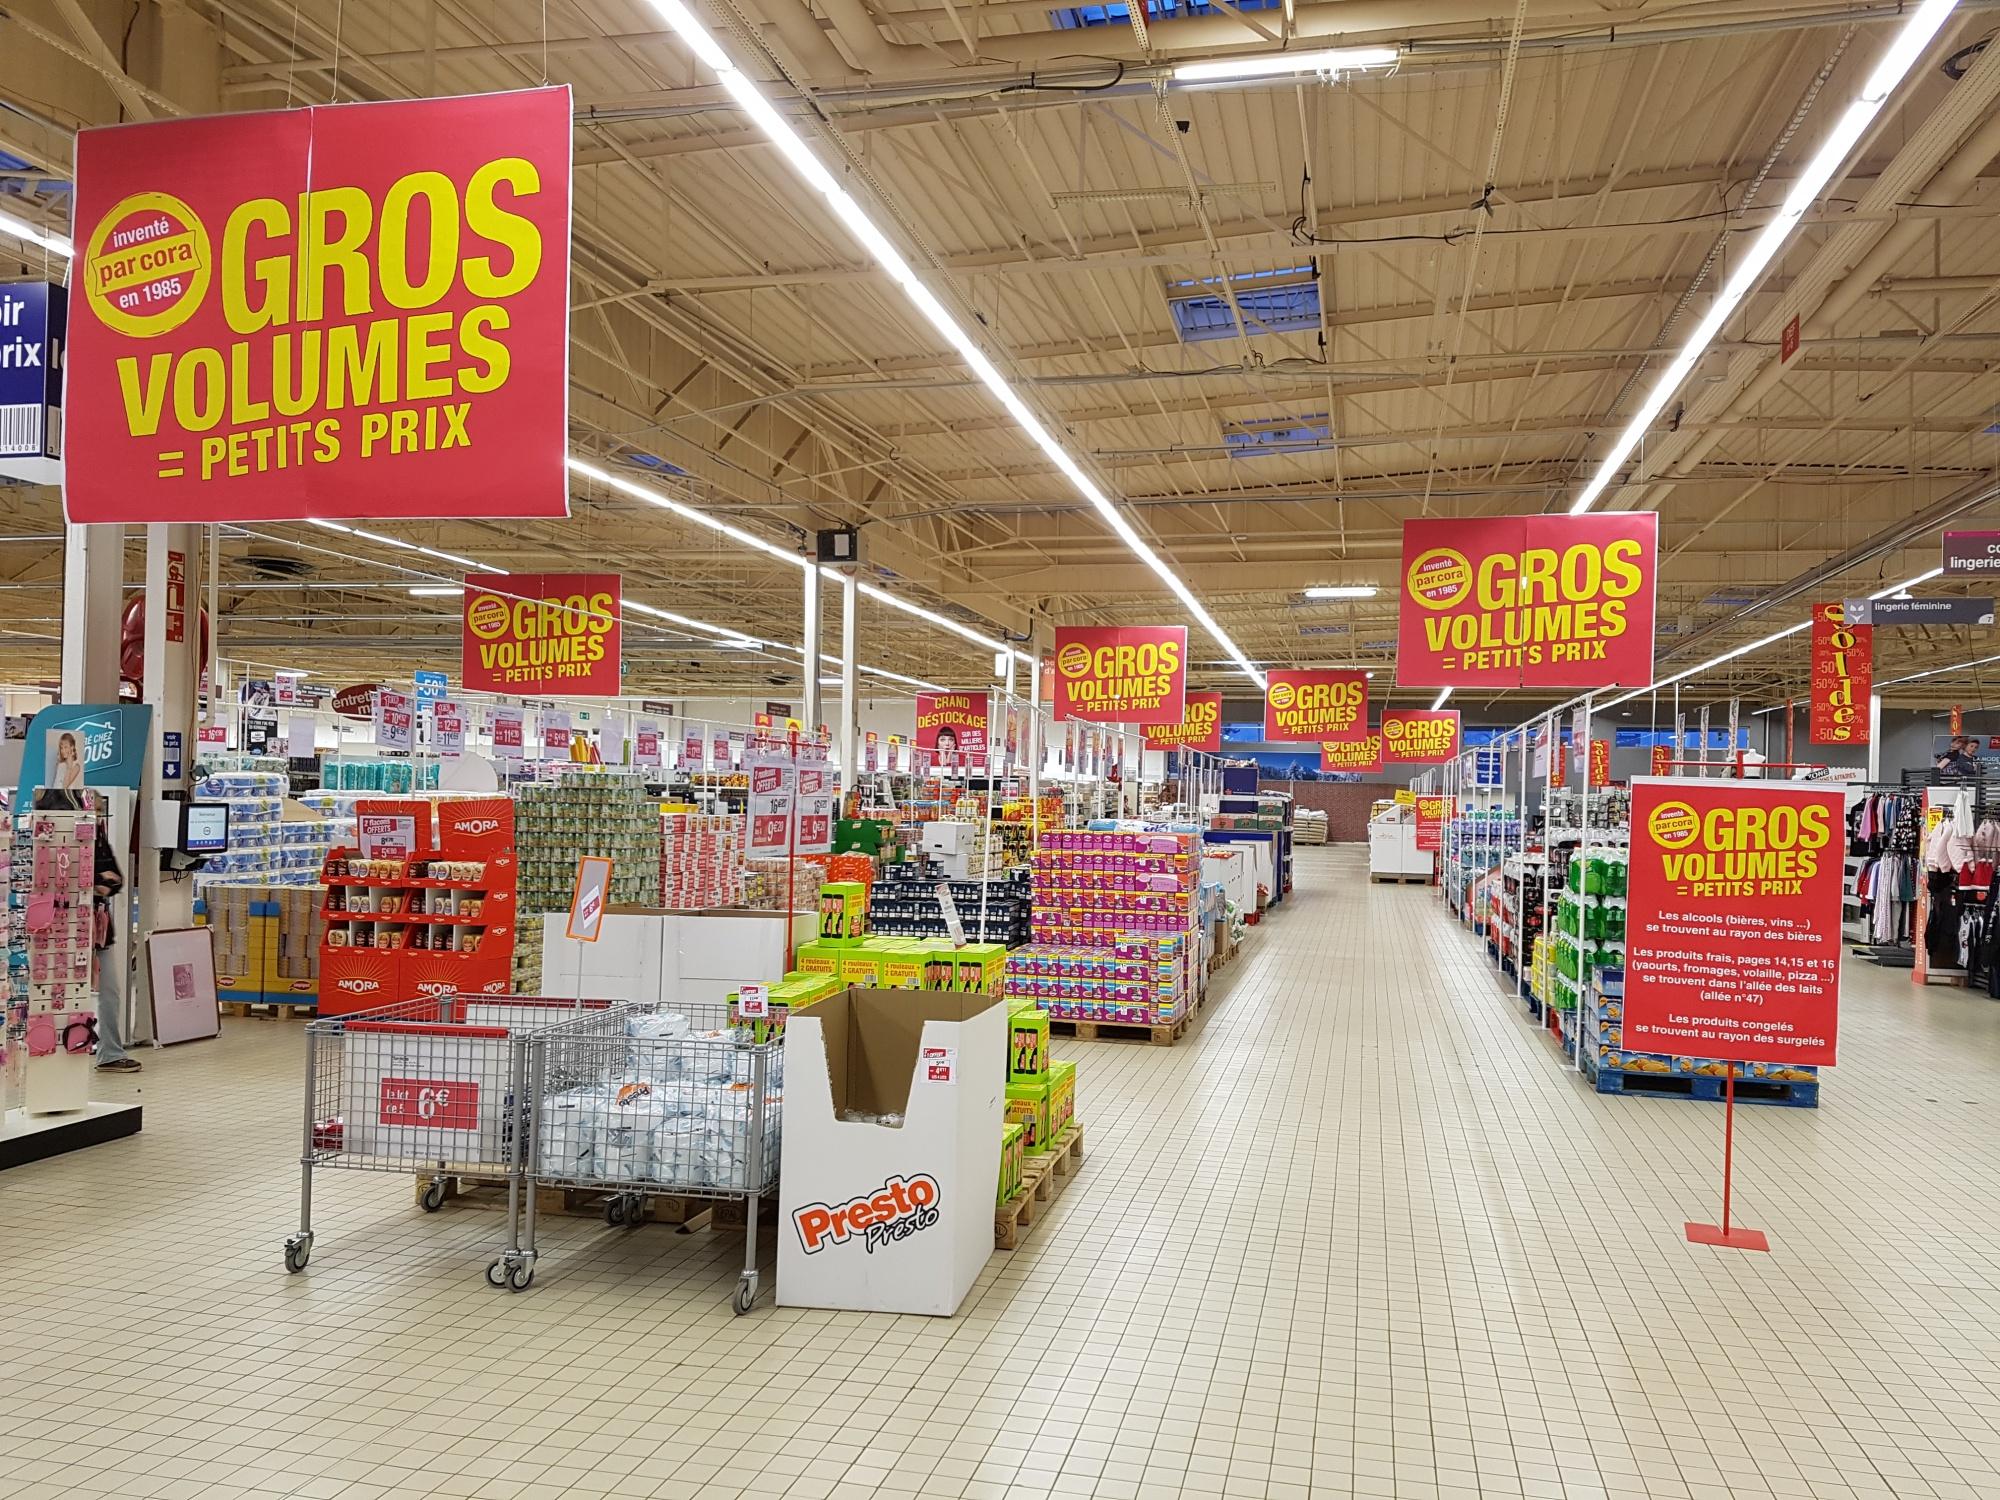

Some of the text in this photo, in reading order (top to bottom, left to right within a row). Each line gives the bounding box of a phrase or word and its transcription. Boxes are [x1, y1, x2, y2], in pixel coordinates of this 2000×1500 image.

[113, 216, 169, 248] inventé
[222, 157, 542, 334] GROS
[99, 241, 192, 285] par cora
[119, 277, 181, 309] en 1985
[0, 295, 24, 326] ir
[116, 305, 510, 436] VOLUMES
[201, 418, 340, 480] PETITS
[361, 402, 472, 458] PRIX
[1423, 559, 1453, 572] inventé
[1950, 556, 2000, 570] lingerie
[1416, 569, 1464, 588] par cora
[1477, 539, 1642, 611] GROS
[1426, 585, 1458, 598] en 1985
[513, 593, 613, 640] GROS
[1875, 602, 1952, 612] lingerie féminine
[1424, 600, 1627, 652] VOLUMES
[480, 635, 604, 669] VOLUMES
[1094, 641, 1179, 679] GROS
[1463, 645, 1543, 671] PETITS
[1551, 640, 1607, 663] PRIX
[506, 666, 553, 683] PETITS
[558, 663, 591, 678] PRIX
[1067, 675, 1171, 701] VOLUMES
[1297, 681, 1363, 709] GROS
[935, 696, 970, 709] GRAND
[1087, 700, 1127, 713] PETITS
[1132, 697, 1160, 709] PRIX
[1185, 701, 1217, 723] ROS
[918, 711, 987, 728] DÉSTOCKAGE
[1276, 706, 1357, 726] VOLUMES
[1148, 722, 1213, 739] VOLUMES
[1292, 723, 1349, 735] PETITS PRIX
[1405, 718, 1456, 739] GROS
[1160, 735, 1206, 746] PETITS PRIX
[1389, 737, 1451, 752] VOLUMES
[1327, 751, 1377, 763] VOLUMES
[1660, 810, 1684, 820] inventé
[367, 825, 391, 834] OFFERTS
[454, 819, 499, 834] AMORA
[1655, 818, 1693, 832] par cora
[1672, 830, 1689, 838] 1985
[1703, 804, 1830, 852] GROS
[1662, 850, 1817, 881] VOLUMES
[1693, 881, 1754, 897] PETITS
[1761, 880, 1802, 895] PRIX
[1659, 910, 1679, 920] Les
[1682, 913, 1722, 924] alcools
[1771, 918, 1793, 928] vins
[1646, 924, 1822, 942] se trouvent au rayon des bières
[1633, 947, 1653, 957] Les
[1656, 949, 1703, 961] produits
[1737, 956, 1771, 967] pages
[1807, 959, 1818, 968] et
[1822, 960, 1835, 969] 16
[338, 980, 379, 993] AMORA
[483, 981, 505, 993] AMORA
[1642, 975, 1823, 994] se trouvent dans l'allée des laits
[1788, 972, 1818, 983] pizza
[417, 984, 457, 996] AMORA
[1669, 1014, 1794, 1032] Les produits congelés
[1635, 1024, 1825, 1046] se trouvent au rayon des surgelés
[397, 1089, 410, 1099] lot
[797, 1178, 936, 1250] Presto
[865, 1203, 940, 1254] Presto
